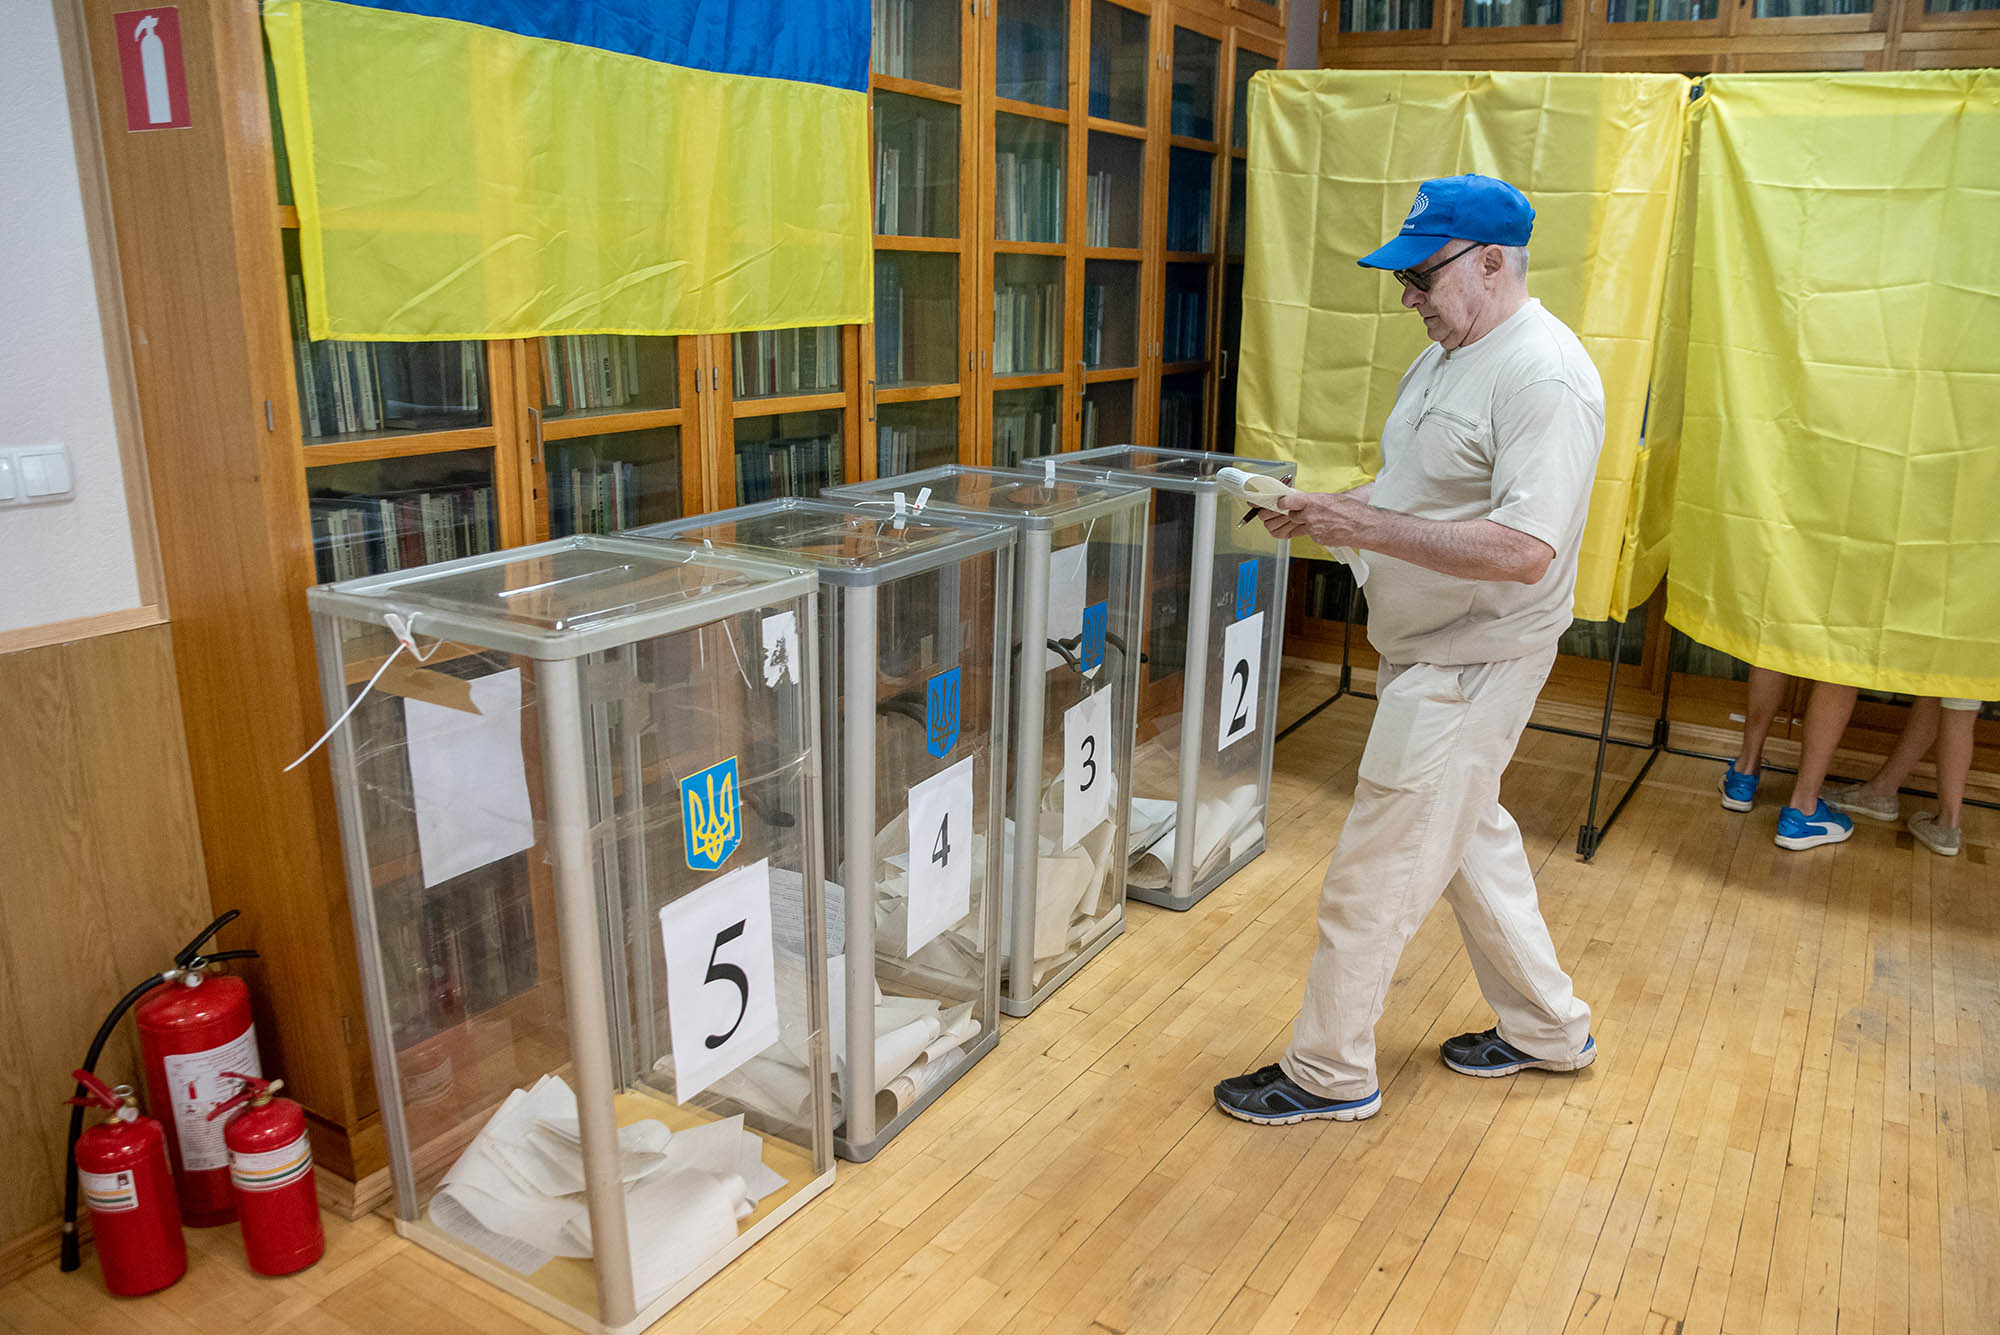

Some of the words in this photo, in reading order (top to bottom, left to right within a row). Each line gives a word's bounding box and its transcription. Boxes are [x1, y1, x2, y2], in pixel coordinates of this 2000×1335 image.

[1226, 658, 1250, 738] 2
[1080, 735, 1097, 792] 3
[932, 812, 951, 868] 4
[704, 918, 749, 1050] 5
